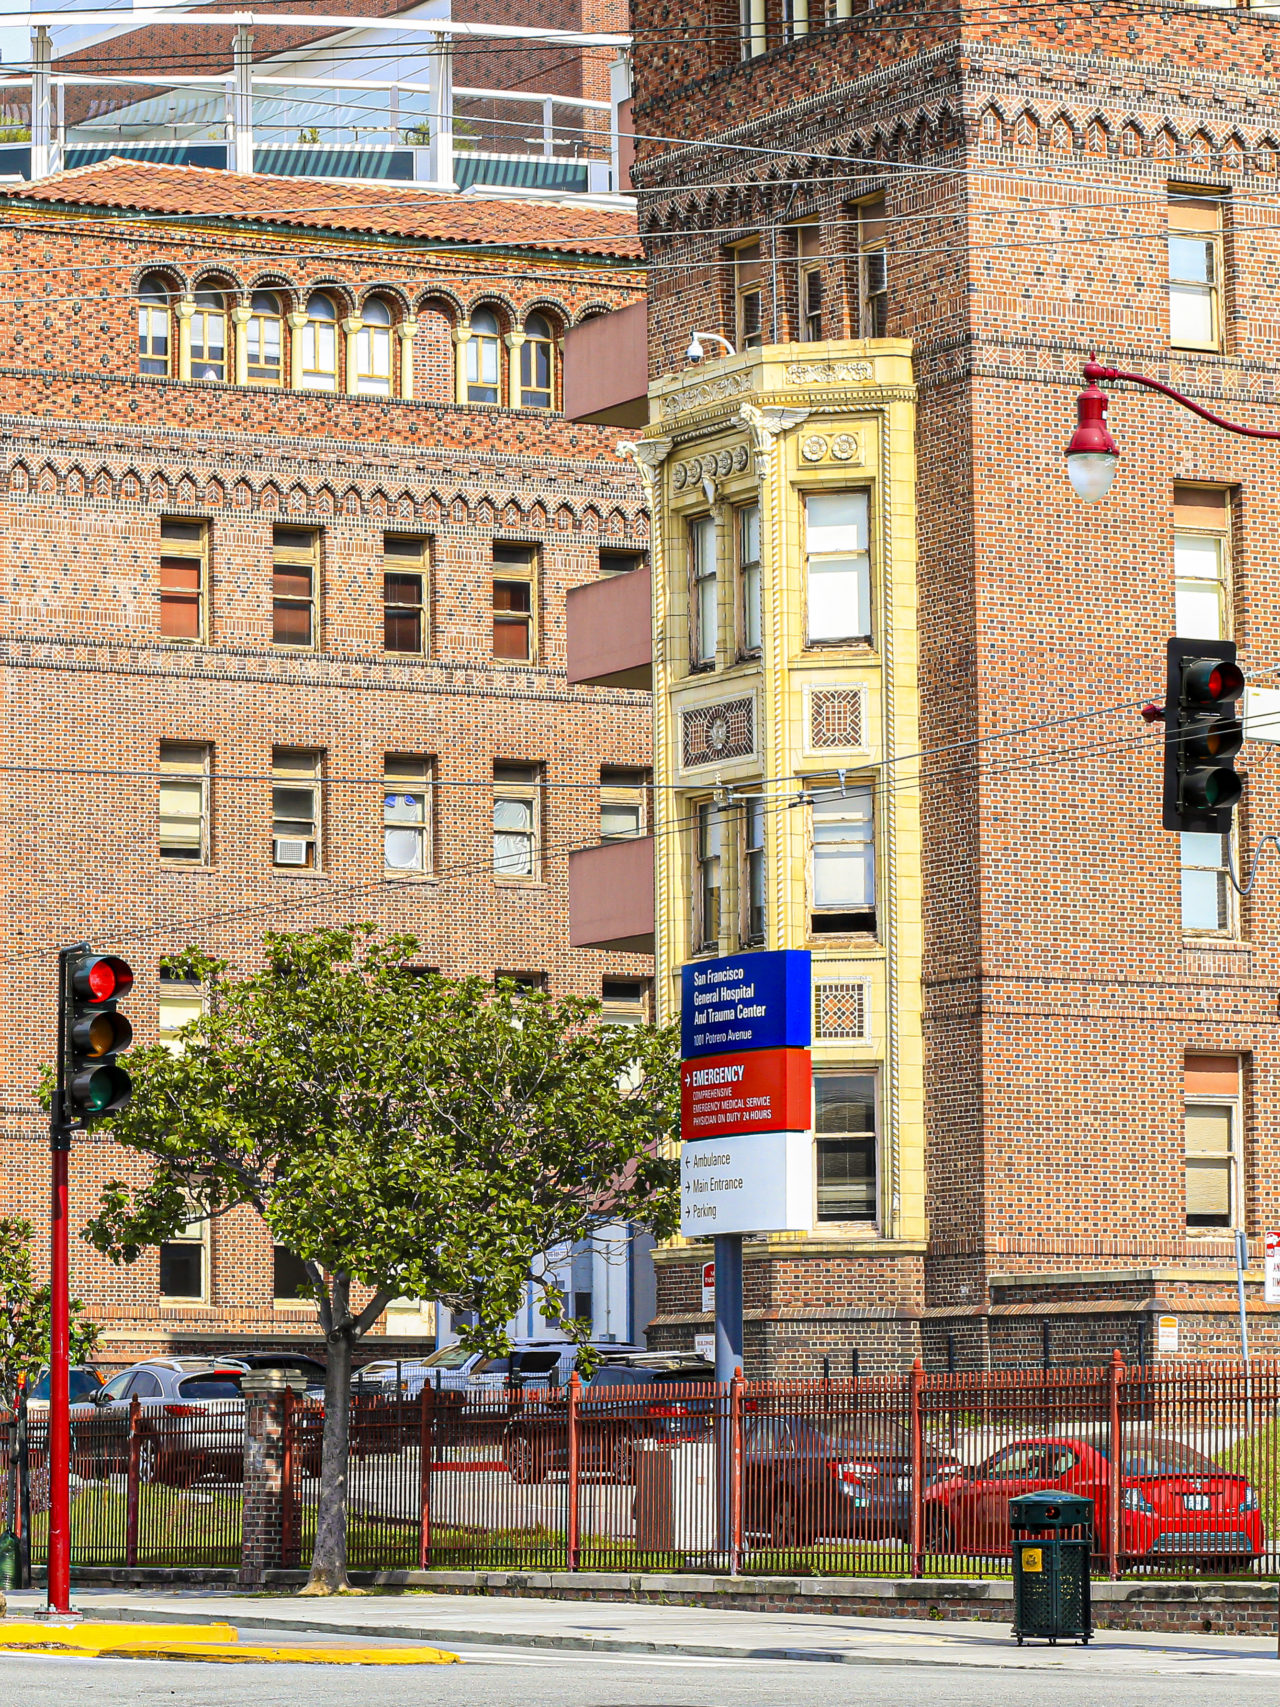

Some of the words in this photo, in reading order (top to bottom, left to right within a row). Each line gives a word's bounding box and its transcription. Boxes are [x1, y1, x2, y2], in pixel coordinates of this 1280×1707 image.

[694, 972, 706, 986] San
[707, 966, 744, 984] Francisco
[694, 988, 719, 1006] General
[720, 983, 755, 1003] Hospital
[693, 1009, 707, 1026] And
[708, 1008, 735, 1023] Trauma
[736, 1004, 766, 1019] Center
[705, 1032, 727, 1044] Potrero
[727, 1029, 752, 1041] Avenue
[692, 1065, 745, 1087] EMERGENCY
[692, 1087, 732, 1100] COMPREHENSIVE
[693, 1101, 720, 1113] EMERGENCY
[721, 1098, 745, 1110] MEDICAL
[746, 1096, 771, 1107] SERVICE
[717, 1113, 726, 1123] ON
[726, 1112, 741, 1122] DUTY
[742, 1111, 750, 1120] 24
[750, 1109, 772, 1119] HOURS
[693, 1152, 731, 1168] Ambulance
[692, 1179, 709, 1193] Main
[710, 1177, 743, 1191] Entrance
[693, 1203, 717, 1219] Parking
